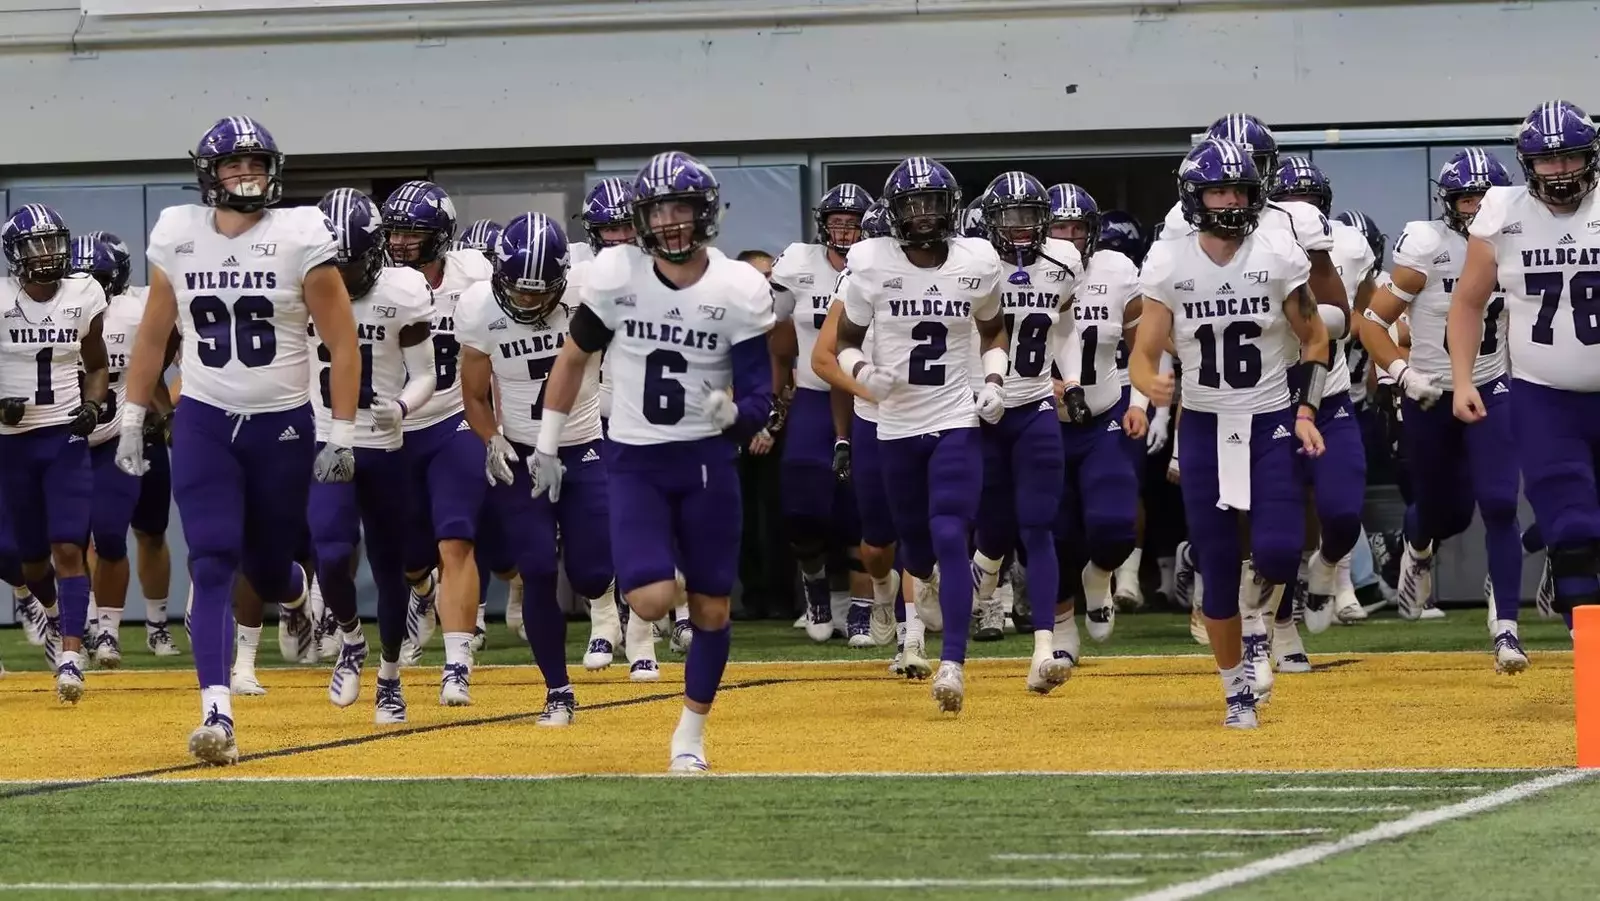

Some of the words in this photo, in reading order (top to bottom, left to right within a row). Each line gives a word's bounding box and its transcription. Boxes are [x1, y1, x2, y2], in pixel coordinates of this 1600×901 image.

[1521, 247, 1600, 267] WILDCAT
[185, 271, 276, 289] WILDCATS
[889, 299, 972, 317] WILDCATS
[1183, 295, 1271, 319] WILDCATS
[1524, 271, 1600, 345] 78
[9, 328, 78, 344] WILDCATS
[190, 296, 277, 369] 96
[499, 330, 569, 359] WILDCA
[624, 319, 718, 351] WILDCATS
[908, 321, 948, 386] 2
[1194, 321, 1262, 390] 16
[35, 347, 54, 406] 1
[643, 348, 688, 426] 6
